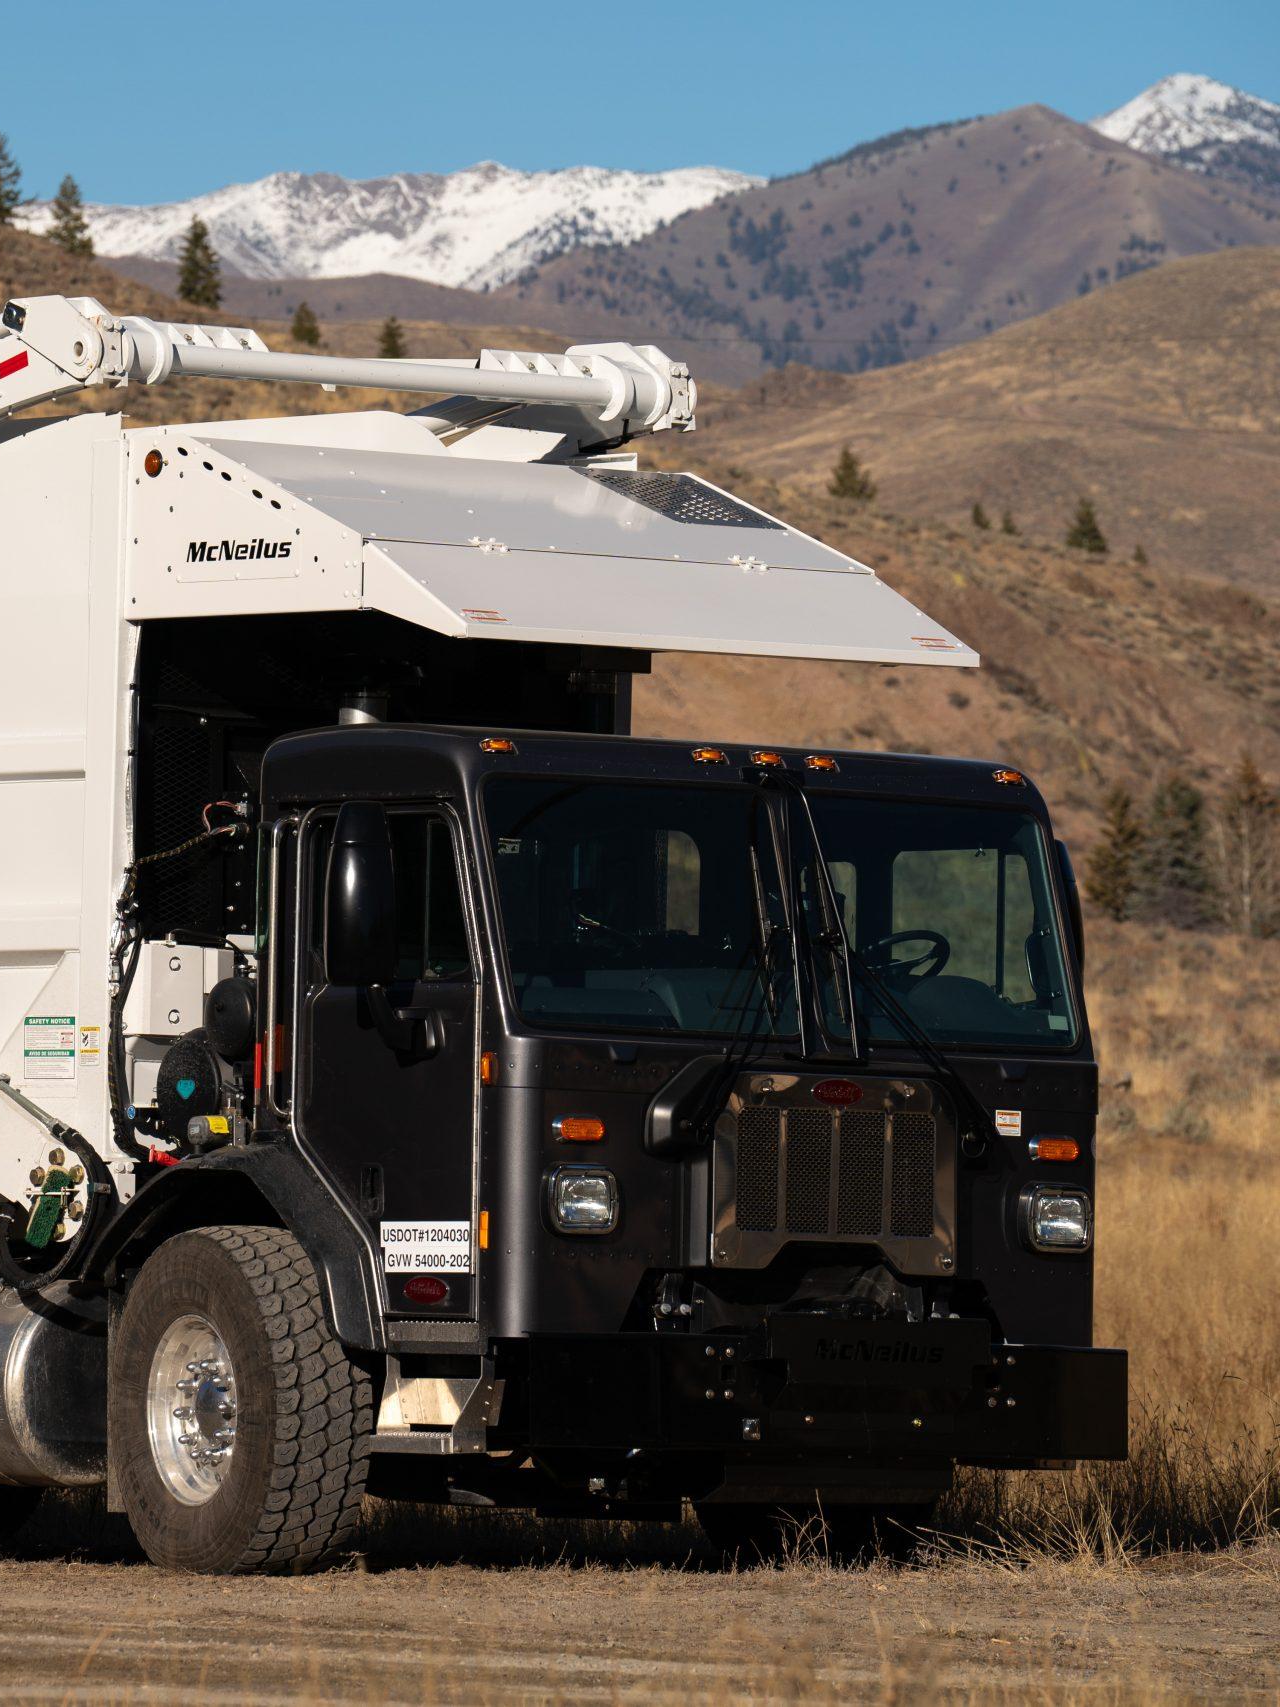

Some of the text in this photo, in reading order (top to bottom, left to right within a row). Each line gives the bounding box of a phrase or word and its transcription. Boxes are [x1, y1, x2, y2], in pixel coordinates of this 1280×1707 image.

[186, 538, 293, 563] McNeilus
[382, 1228, 470, 1243] USDOT#1204030
[387, 1254, 470, 1268] GVW 54000-202
[815, 1338, 945, 1363] McNeilus
